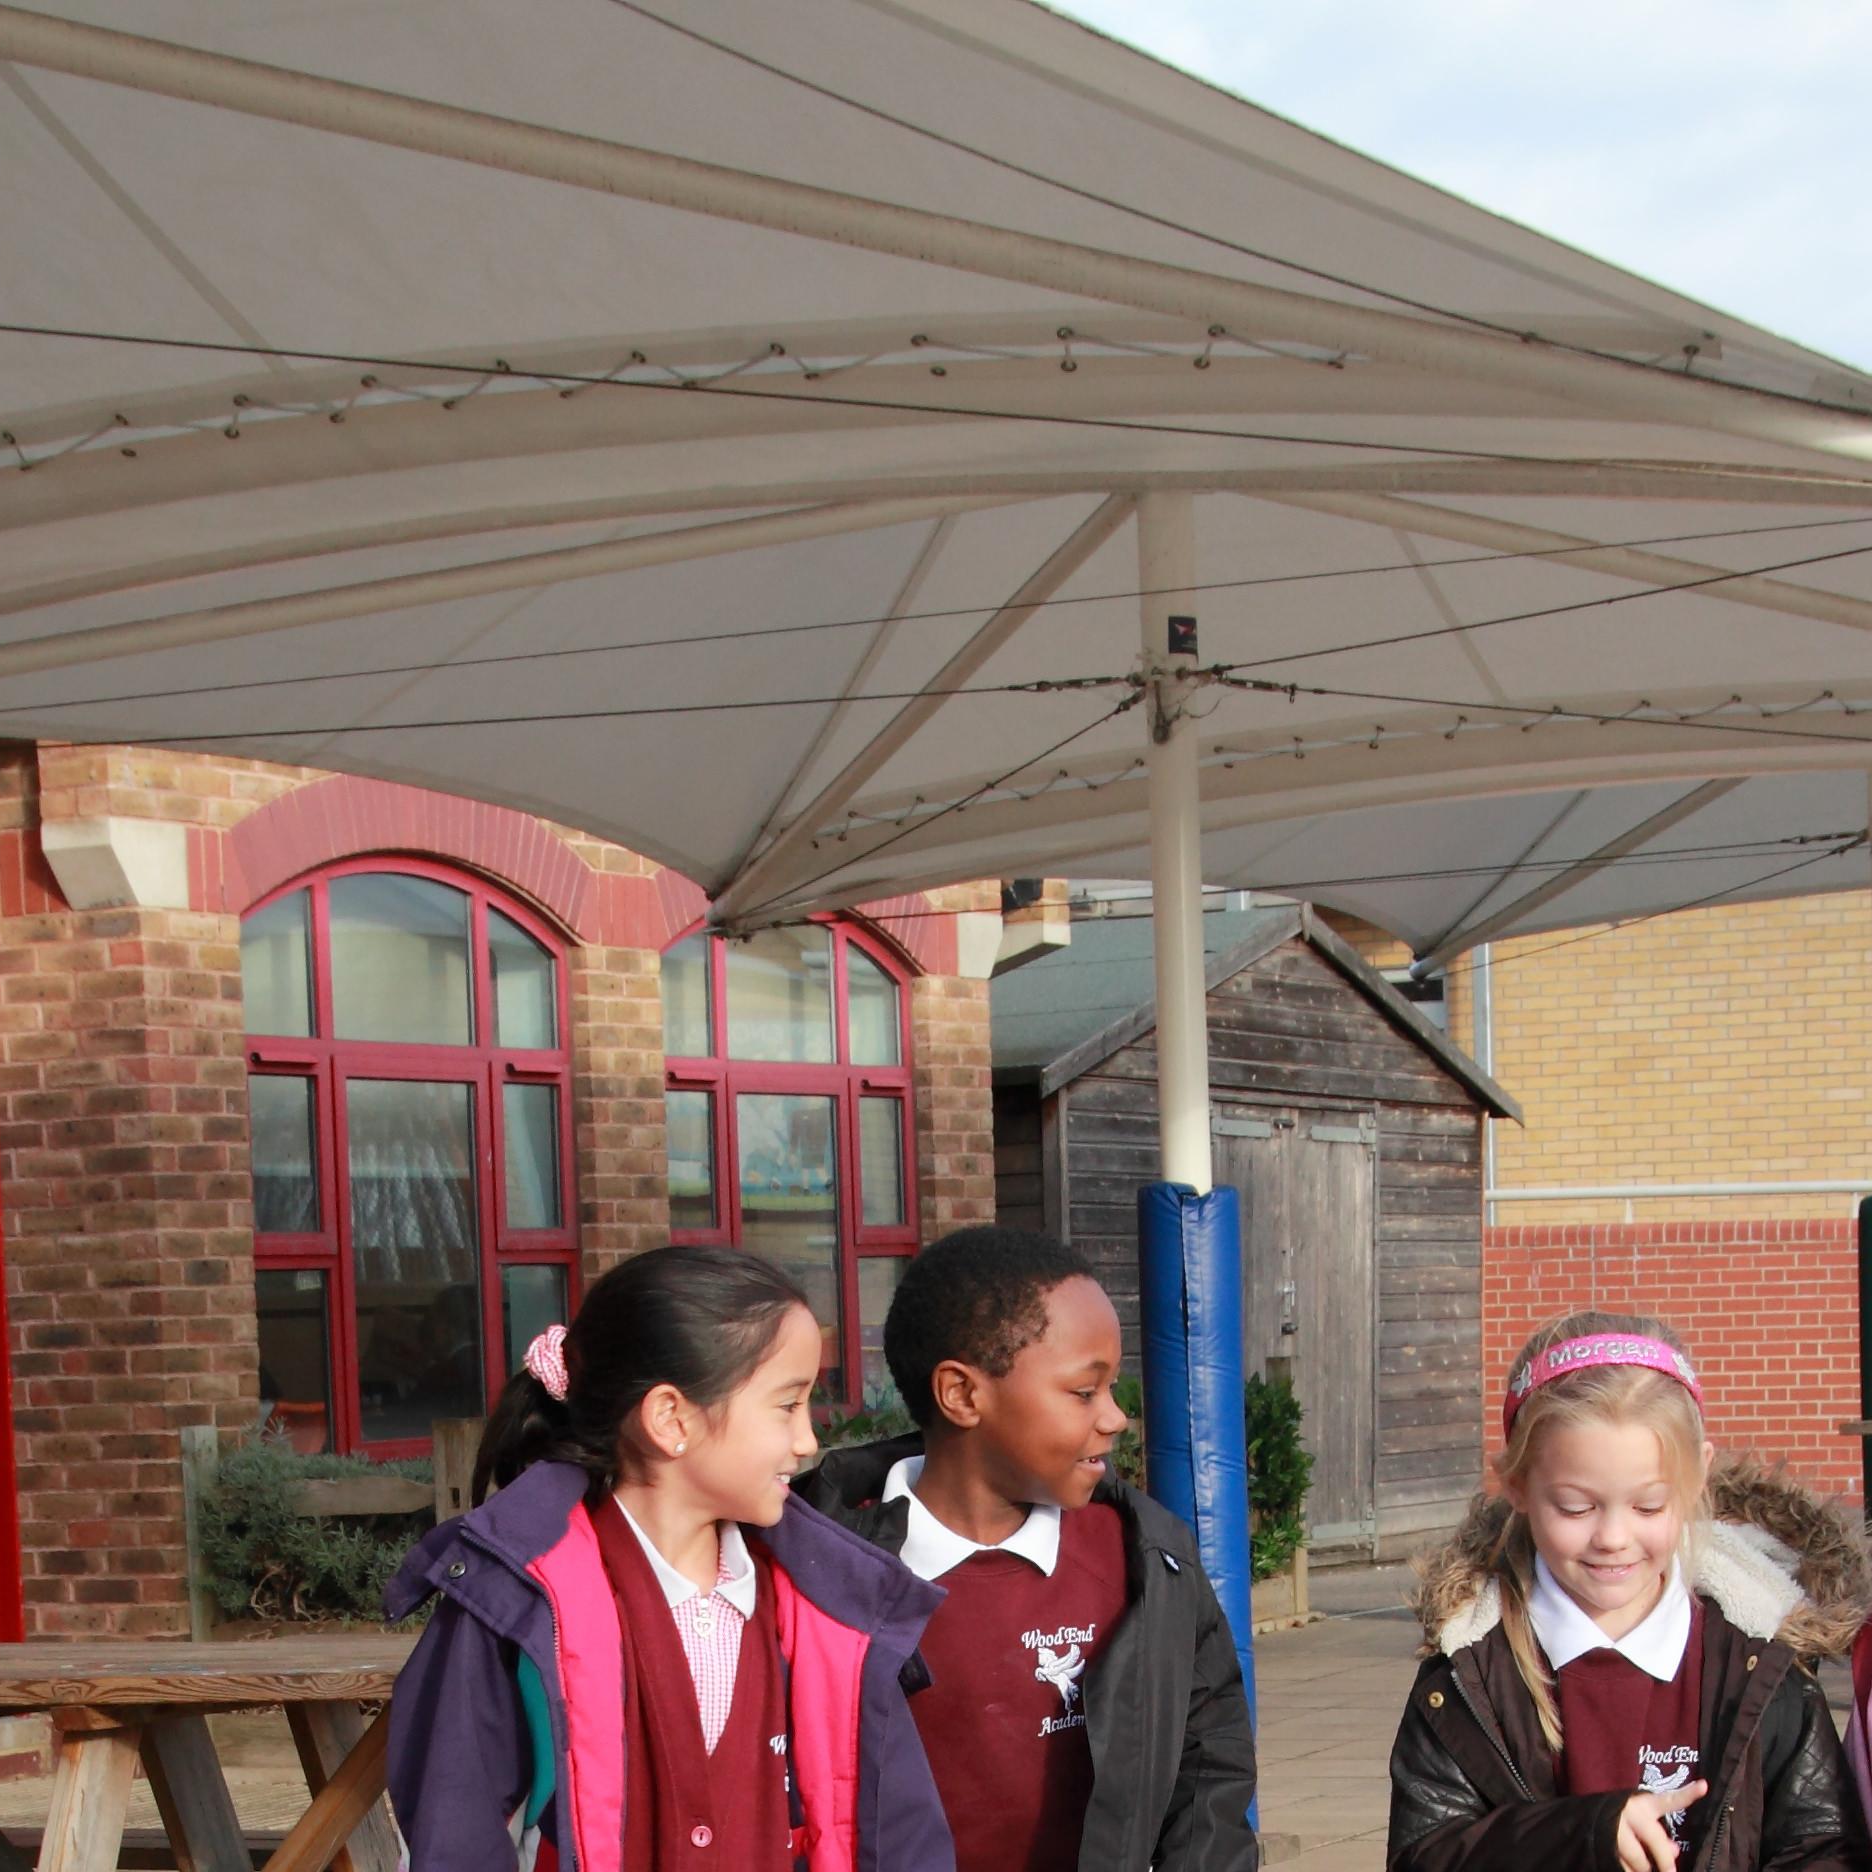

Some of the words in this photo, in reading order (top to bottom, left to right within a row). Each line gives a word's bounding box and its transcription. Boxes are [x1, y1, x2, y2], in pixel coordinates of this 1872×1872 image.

[1547, 1341, 1658, 1368] Morgan
[1021, 1626, 1066, 1649] Wood
[1064, 1623, 1096, 1644] End
[1037, 1710, 1085, 1737] Academ
[1674, 1745, 1699, 1763] En
